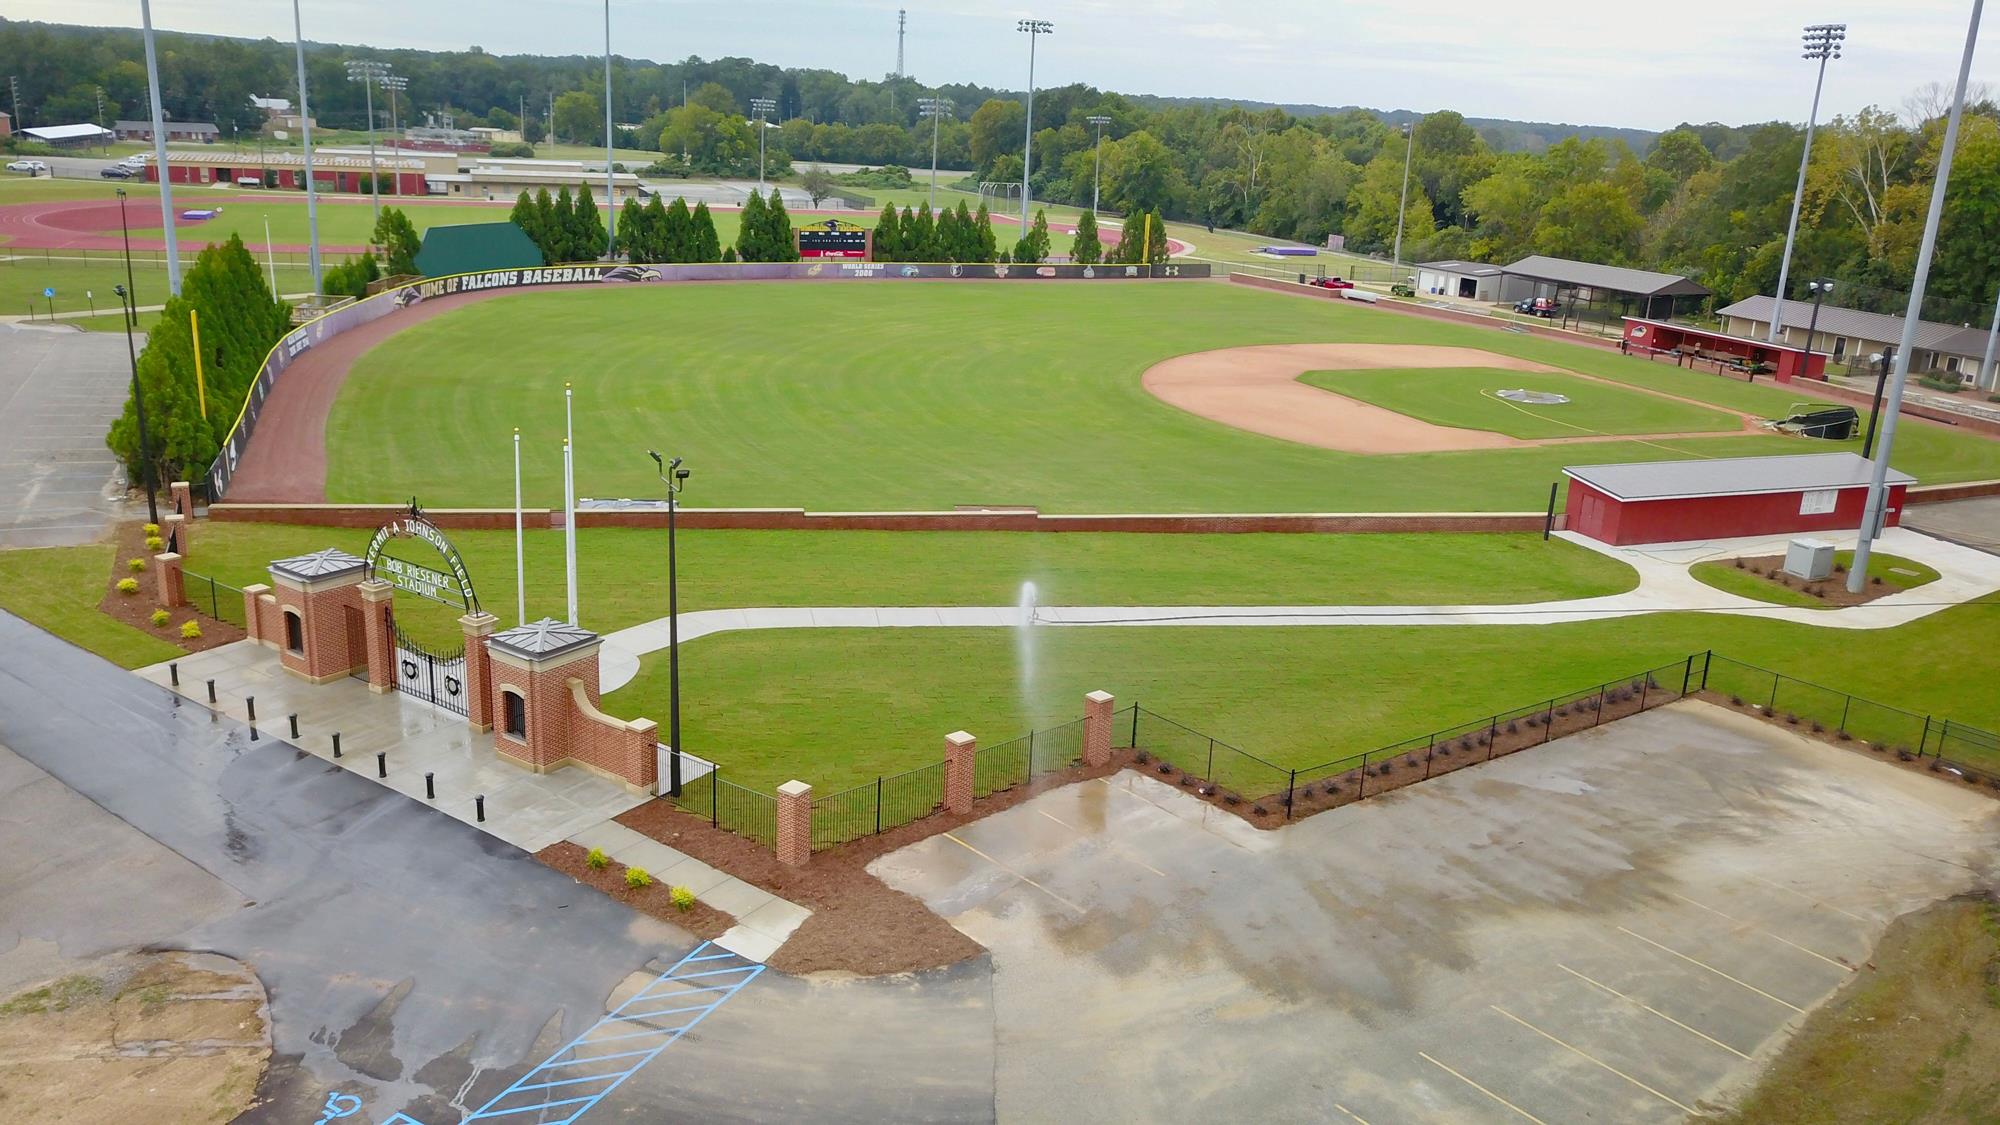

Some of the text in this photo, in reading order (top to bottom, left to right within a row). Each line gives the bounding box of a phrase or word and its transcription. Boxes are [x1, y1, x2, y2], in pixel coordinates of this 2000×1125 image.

[421, 268, 602, 298] HOME OF FALCONS BASEBALL
[367, 519, 472, 598] KERMIT A JOHNSON FIELD
[387, 559, 449, 588] BOB RIESENER
[397, 576, 437, 597] STADIUM
